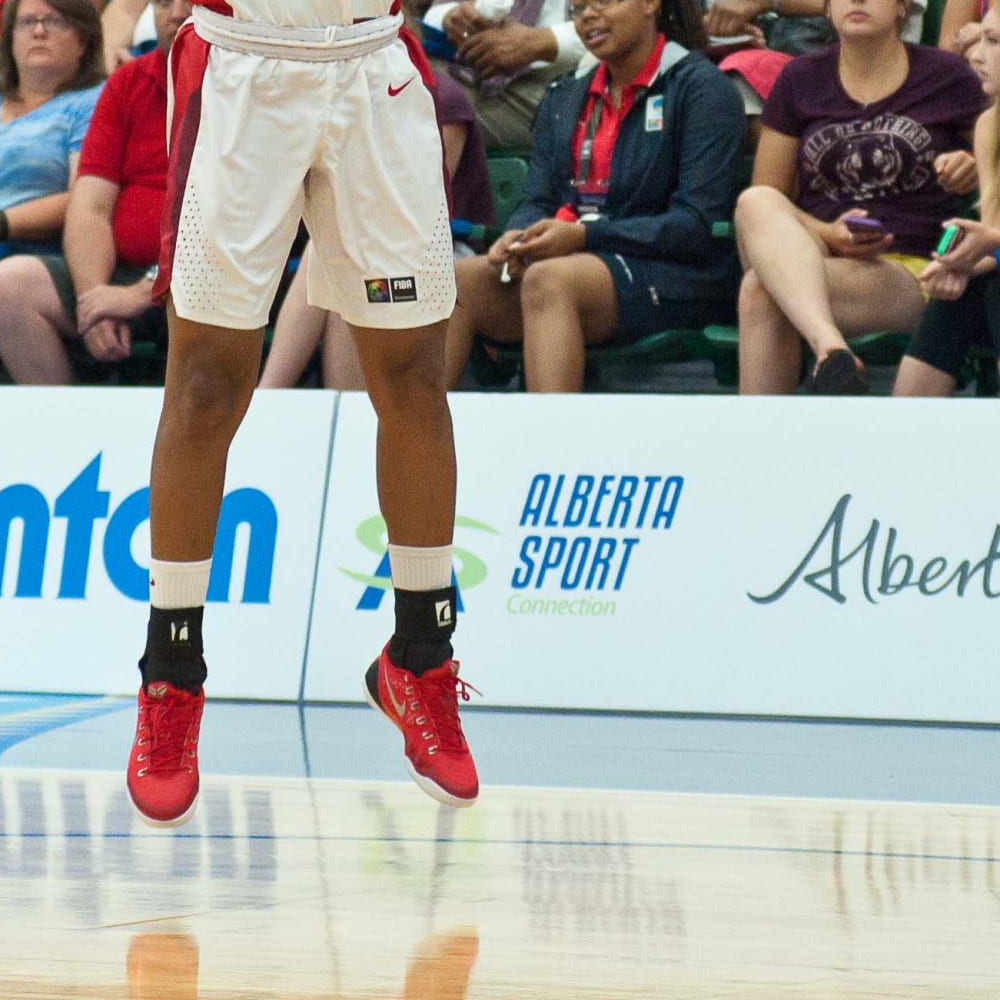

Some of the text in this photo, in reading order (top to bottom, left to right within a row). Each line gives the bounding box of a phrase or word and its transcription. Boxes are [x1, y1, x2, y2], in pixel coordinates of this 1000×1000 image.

[393, 279, 413, 290] FIBA
[519, 474, 684, 530] ALBERTA
[511, 536, 640, 591] SPORT
[507, 594, 616, 617] Connection
